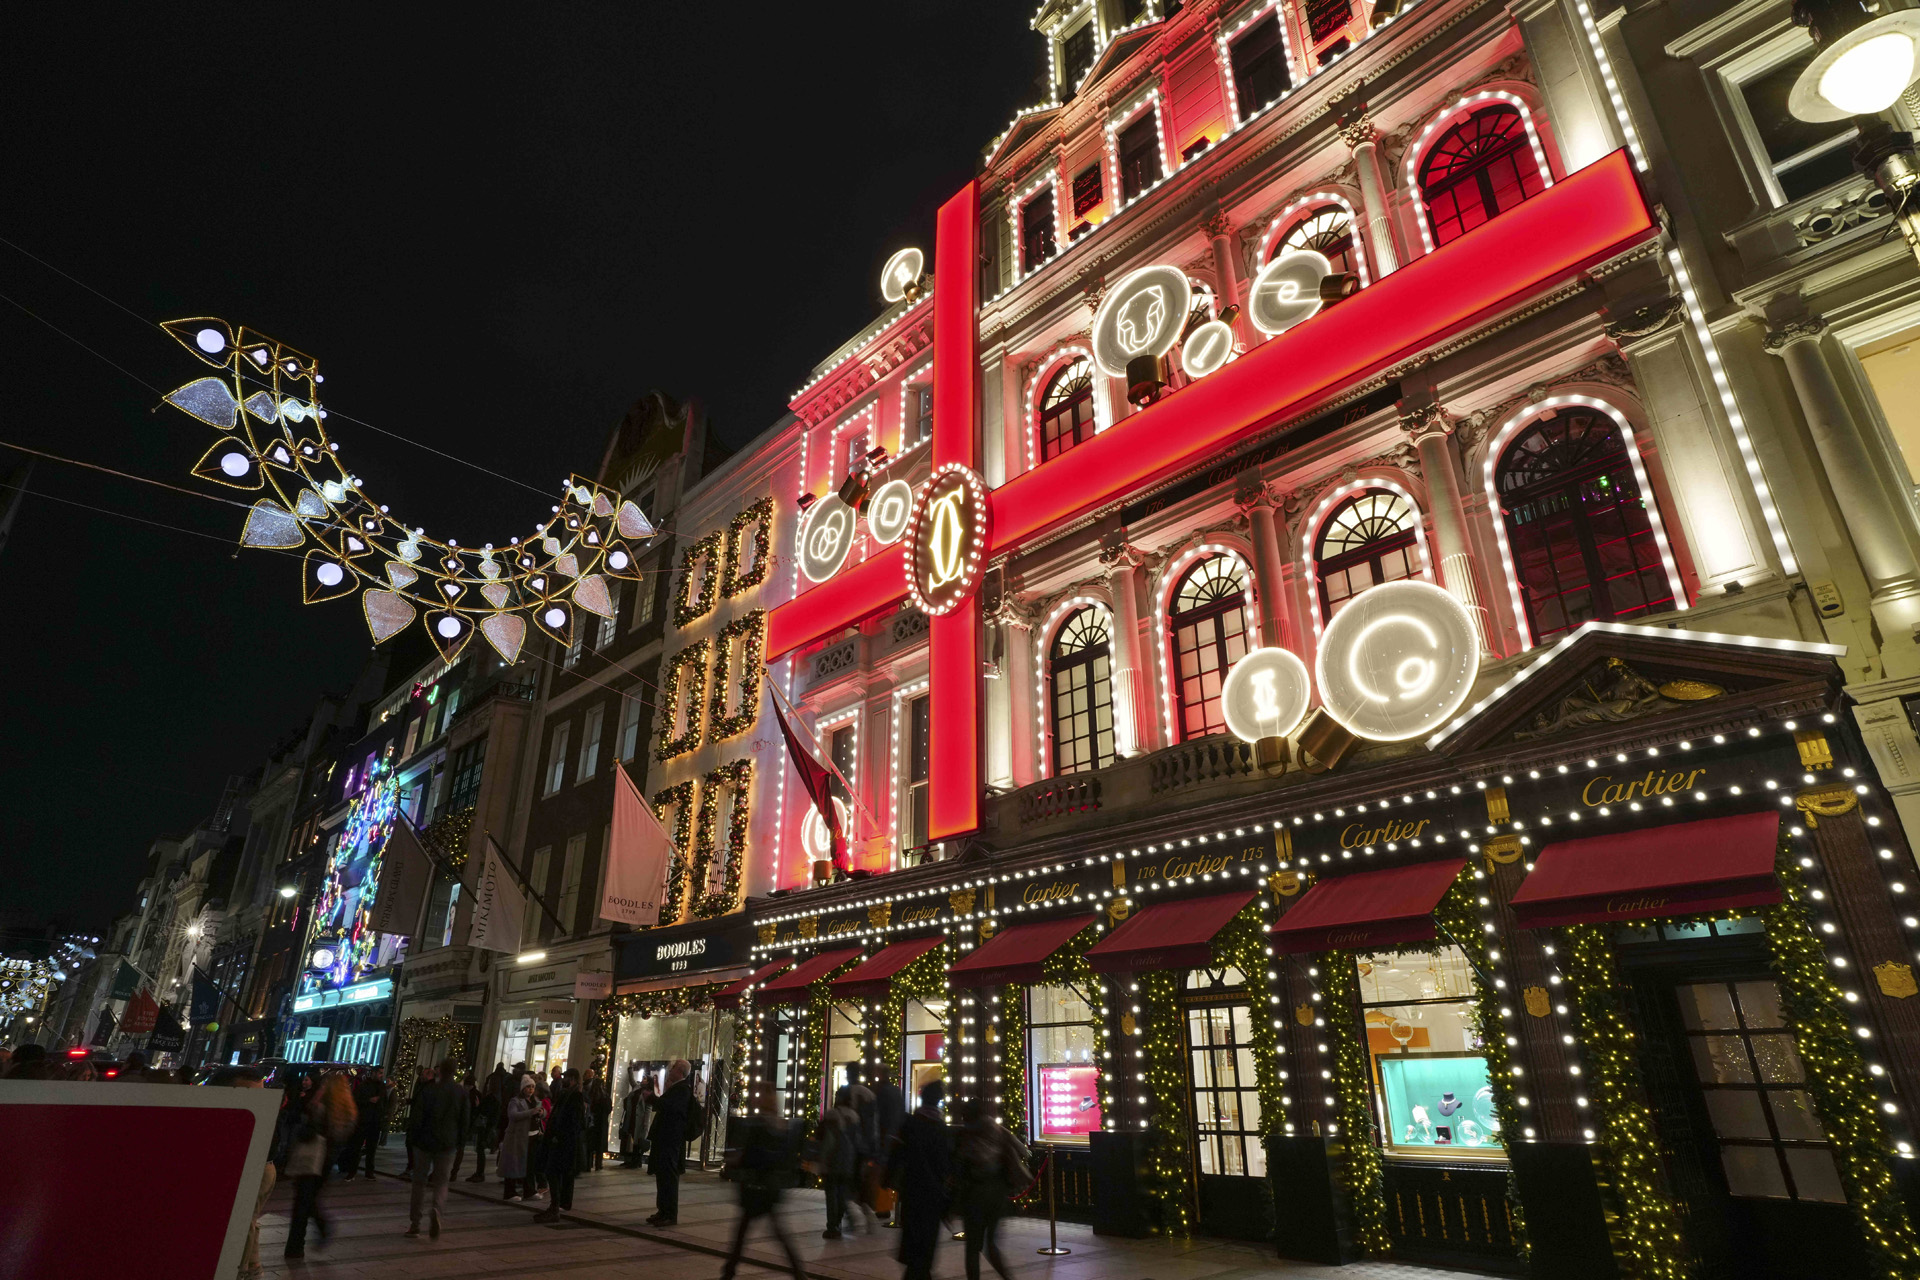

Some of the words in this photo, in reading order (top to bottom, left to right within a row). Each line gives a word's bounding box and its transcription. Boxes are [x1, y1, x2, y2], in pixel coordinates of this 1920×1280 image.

[1144, 498, 1167, 517] 176
[1208, 448, 1270, 487] Cartier
[1342, 403, 1369, 426] 175
[1582, 768, 1707, 807] Cartier
[1339, 818, 1431, 850] Cartier
[1136, 865, 1157, 880] 176
[1162, 854, 1234, 881] Cartier
[1240, 846, 1265, 862] 175
[391, 861, 404, 893] DAVID
[475, 860, 497, 941] MIKIMOTO
[608, 895, 654, 910] BOODLES
[1023, 881, 1080, 904] Cartier
[379, 891, 397, 928] MORRIS
[901, 906, 941, 923] Cartier
[1607, 896, 1670, 914] Cartier
[827, 919, 861, 935] Cartier
[1326, 929, 1372, 945] Cartier
[656, 938, 707, 961] BOODLES
[543, 1008, 572, 1016] MIKIMOTO
